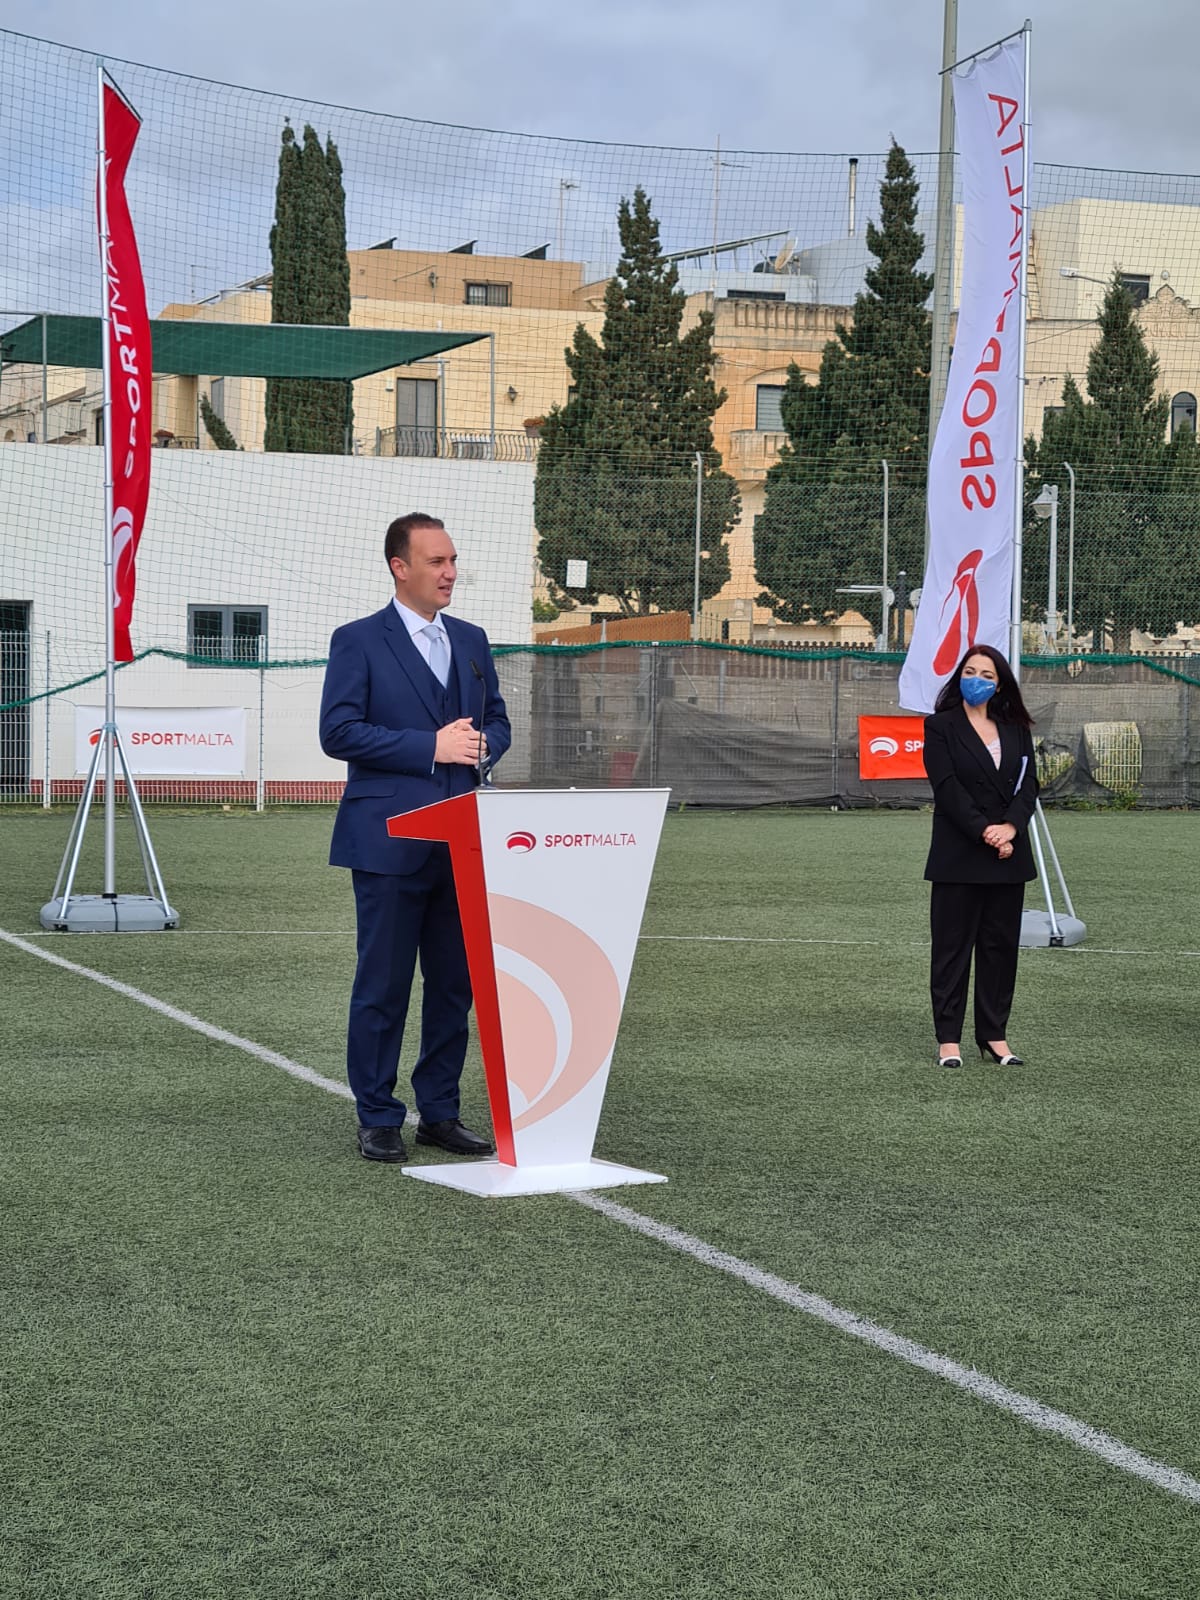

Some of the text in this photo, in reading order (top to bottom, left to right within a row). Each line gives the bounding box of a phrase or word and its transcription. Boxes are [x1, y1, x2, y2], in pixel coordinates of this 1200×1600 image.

[131, 732, 234, 746] SPORTMALTA
[904, 740, 925, 752] SP
[544, 833, 637, 848] SPORTMALTA
